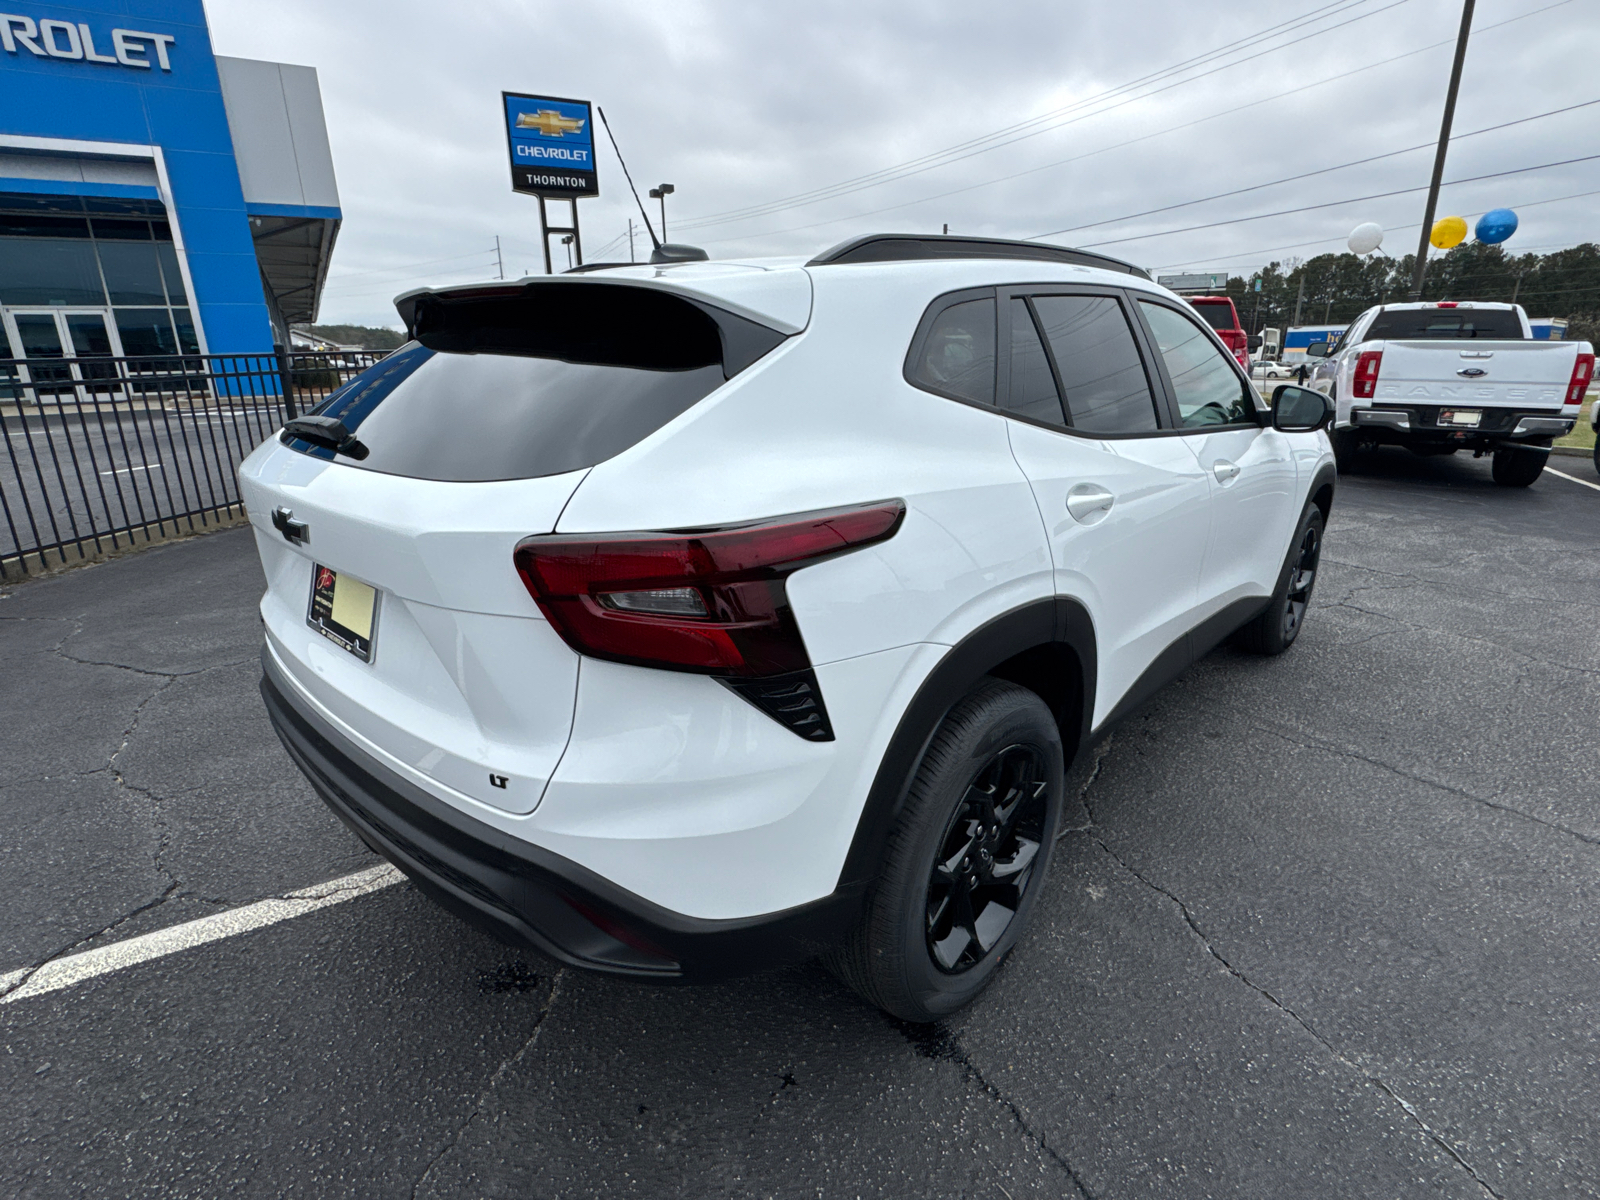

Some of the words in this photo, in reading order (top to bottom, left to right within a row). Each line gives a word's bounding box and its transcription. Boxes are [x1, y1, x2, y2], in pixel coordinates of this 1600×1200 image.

[516, 145, 588, 161] CHEVROLET
[526, 174, 586, 187] THORNTON
[489, 773, 509, 789] LT
